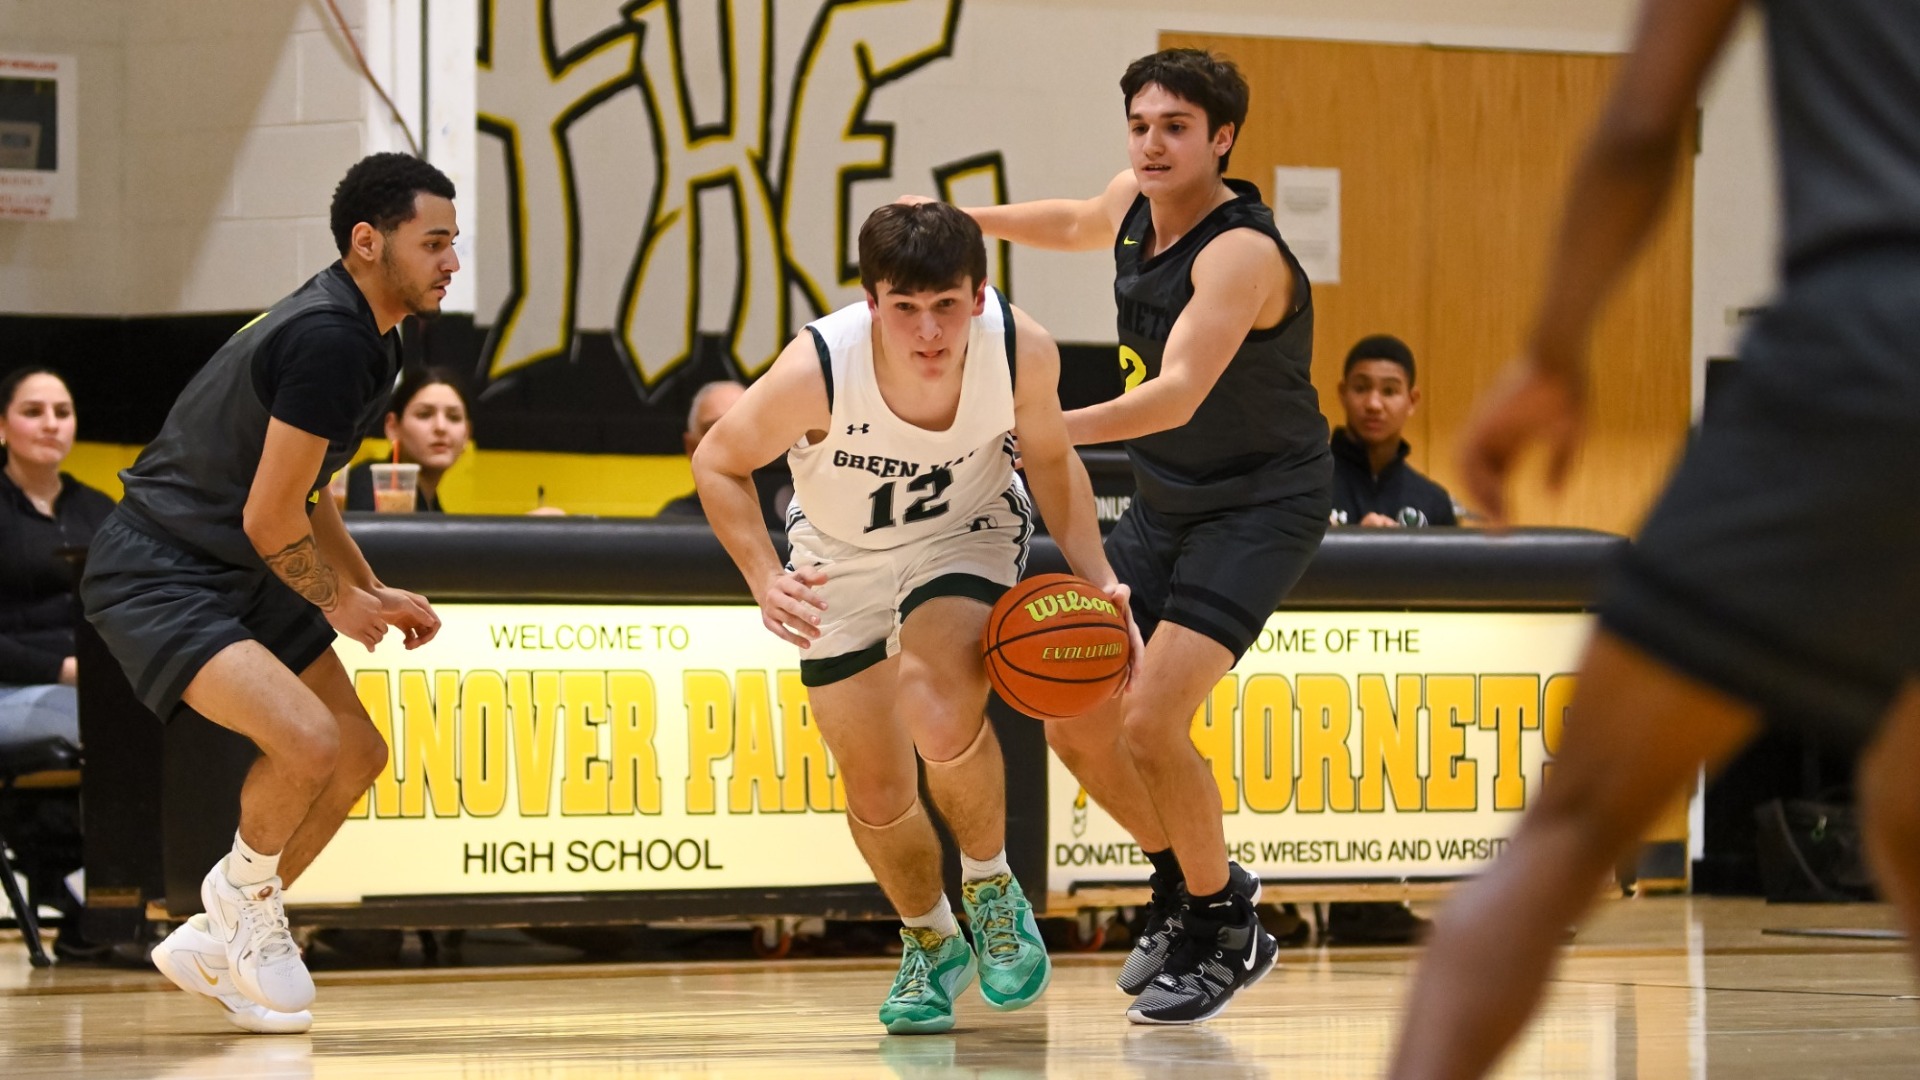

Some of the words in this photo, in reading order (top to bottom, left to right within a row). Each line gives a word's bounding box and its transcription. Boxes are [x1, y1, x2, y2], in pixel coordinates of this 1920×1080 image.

[833, 450, 919, 478] GREEN
[863, 467, 953, 534] 12
[1024, 590, 1118, 622] Wilson
[490, 624, 642, 650] WELCOME
[652, 625, 689, 650] TO
[1250, 628, 1316, 653] OME
[1325, 628, 1360, 653] OF
[1368, 629, 1420, 653] THE
[1041, 643, 1123, 661] EVOLUTION
[347, 669, 662, 819] ANOVER
[464, 841, 554, 874] HIGH
[566, 838, 724, 873] SCHOOL
[1226, 841, 1256, 864] HS
[1261, 840, 1382, 863] WRESTLING
[1388, 839, 1431, 861] AND
[1437, 837, 1511, 861] VARSIT
